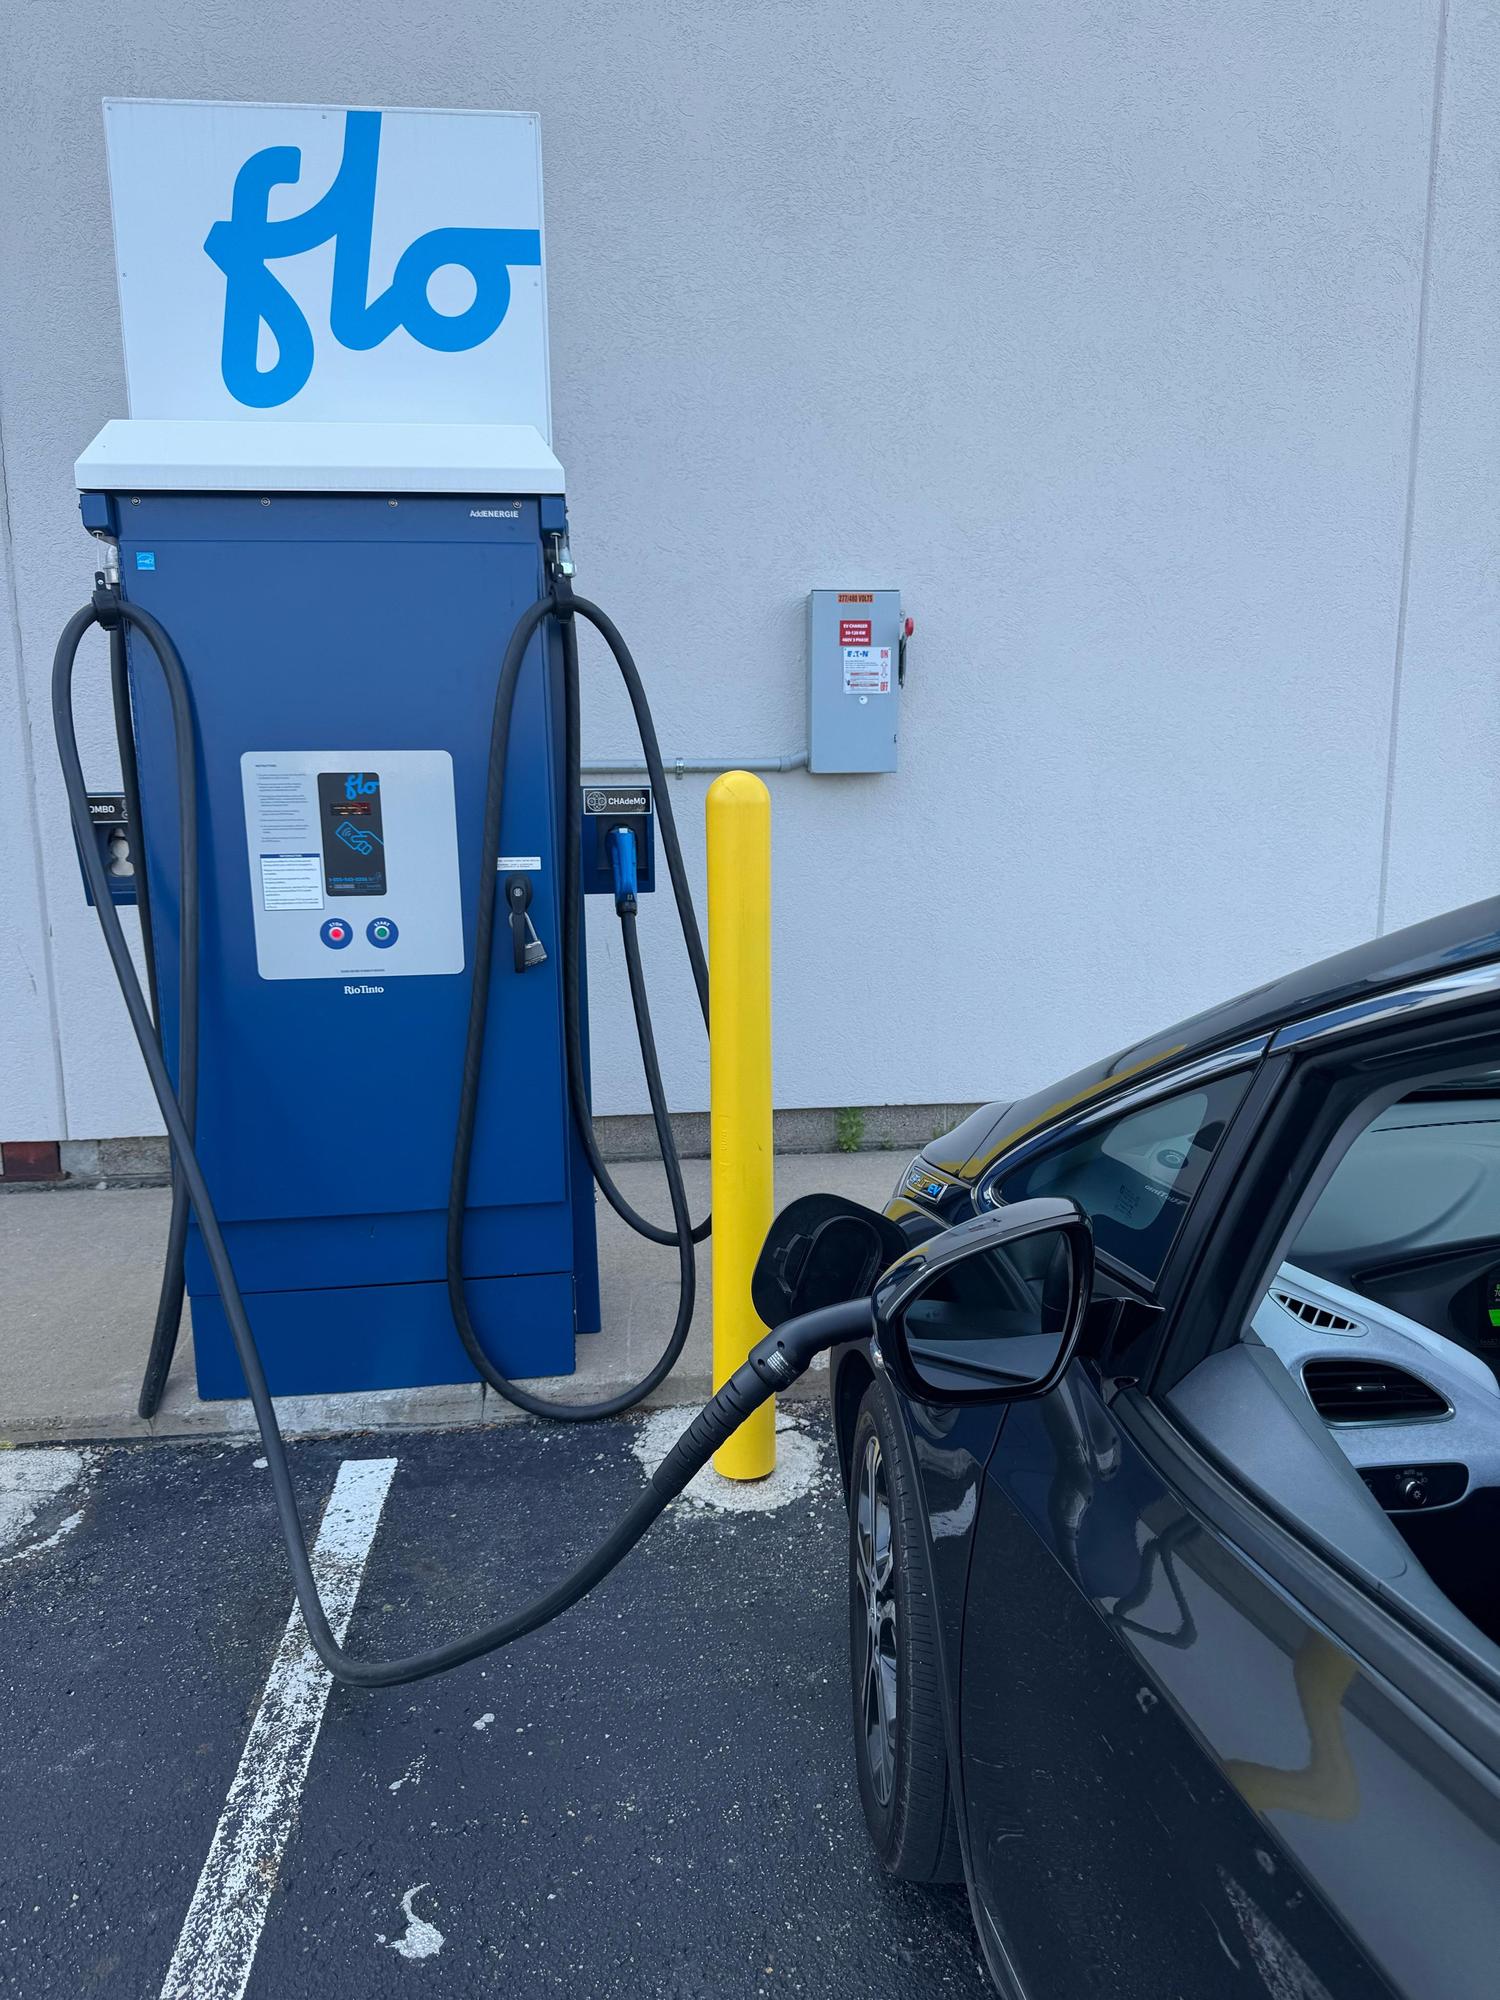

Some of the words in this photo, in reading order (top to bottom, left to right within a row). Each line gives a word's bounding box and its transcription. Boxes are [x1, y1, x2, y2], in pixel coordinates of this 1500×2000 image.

[203, 111, 541, 409] flo
[470, 510, 519, 518] AddENERGIE
[858, 594, 872, 602] VOLTS
[344, 773, 379, 800] flo
[608, 797, 646, 805] CHAdeMO
[89, 805, 115, 813] OMBO
